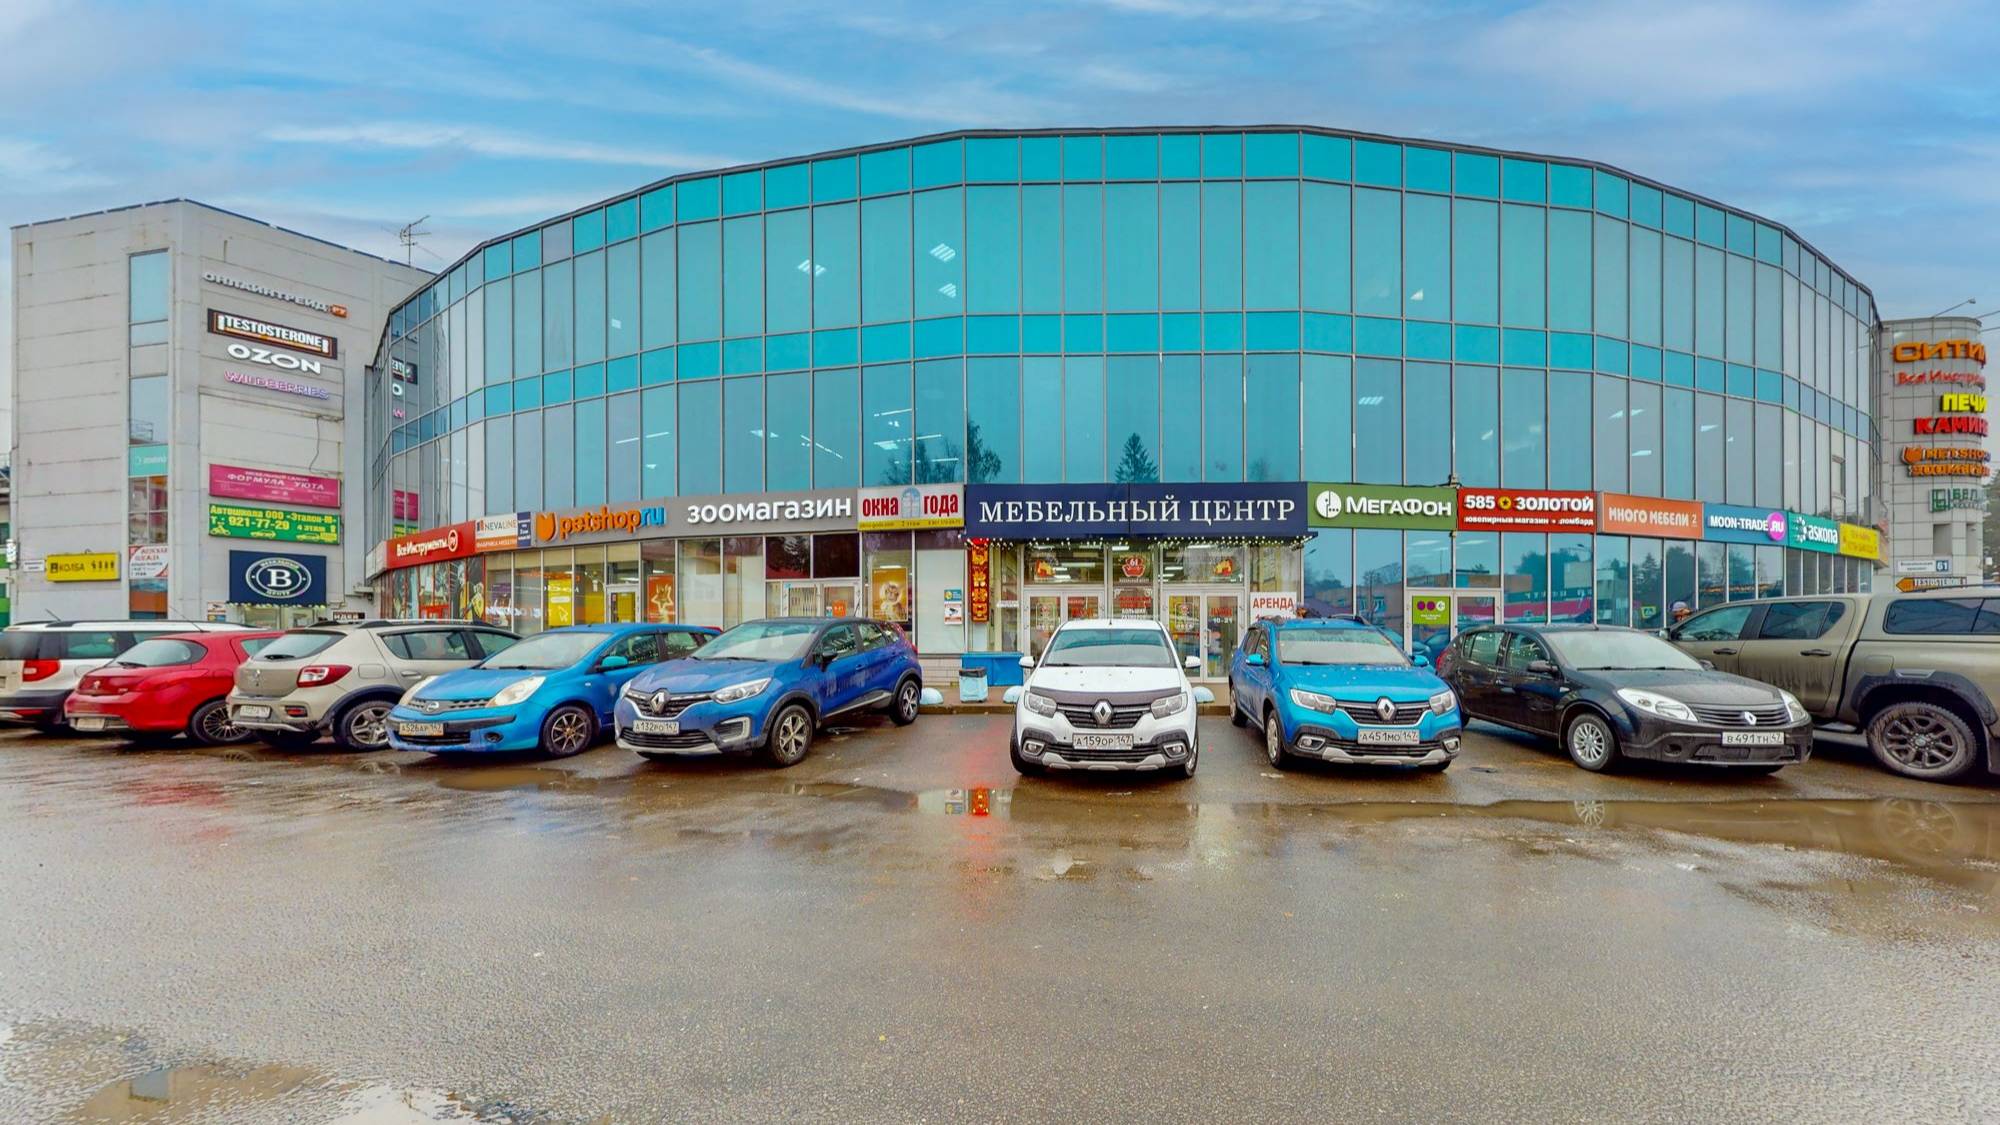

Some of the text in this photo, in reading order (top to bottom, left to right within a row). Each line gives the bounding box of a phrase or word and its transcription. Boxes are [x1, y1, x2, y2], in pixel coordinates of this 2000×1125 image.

[225, 315, 322, 347] TESTOSTERONE
[227, 343, 321, 374] OZON
[227, 473, 285, 487] ФОРМУЛА
[294, 481, 324, 491] УЮТА
[979, 494, 1296, 526] МЕБЕЛЬНЫЙ ЦЕНТР
[1465, 495, 1495, 510] 585
[1516, 496, 1594, 512] ЗОЛОТОЙ
[1515, 517, 1549, 525] магазин
[1558, 517, 1594, 526] ломбард
[1609, 506, 1648, 524] МНОГО
[1650, 510, 1690, 527] МЕБЕЛИ
[485, 519, 516, 532] NEVALINE
[1808, 527, 1838, 544] askona
[1253, 596, 1294, 611] АРЕНДА
[1076, 735, 1113, 746] А159ОР
